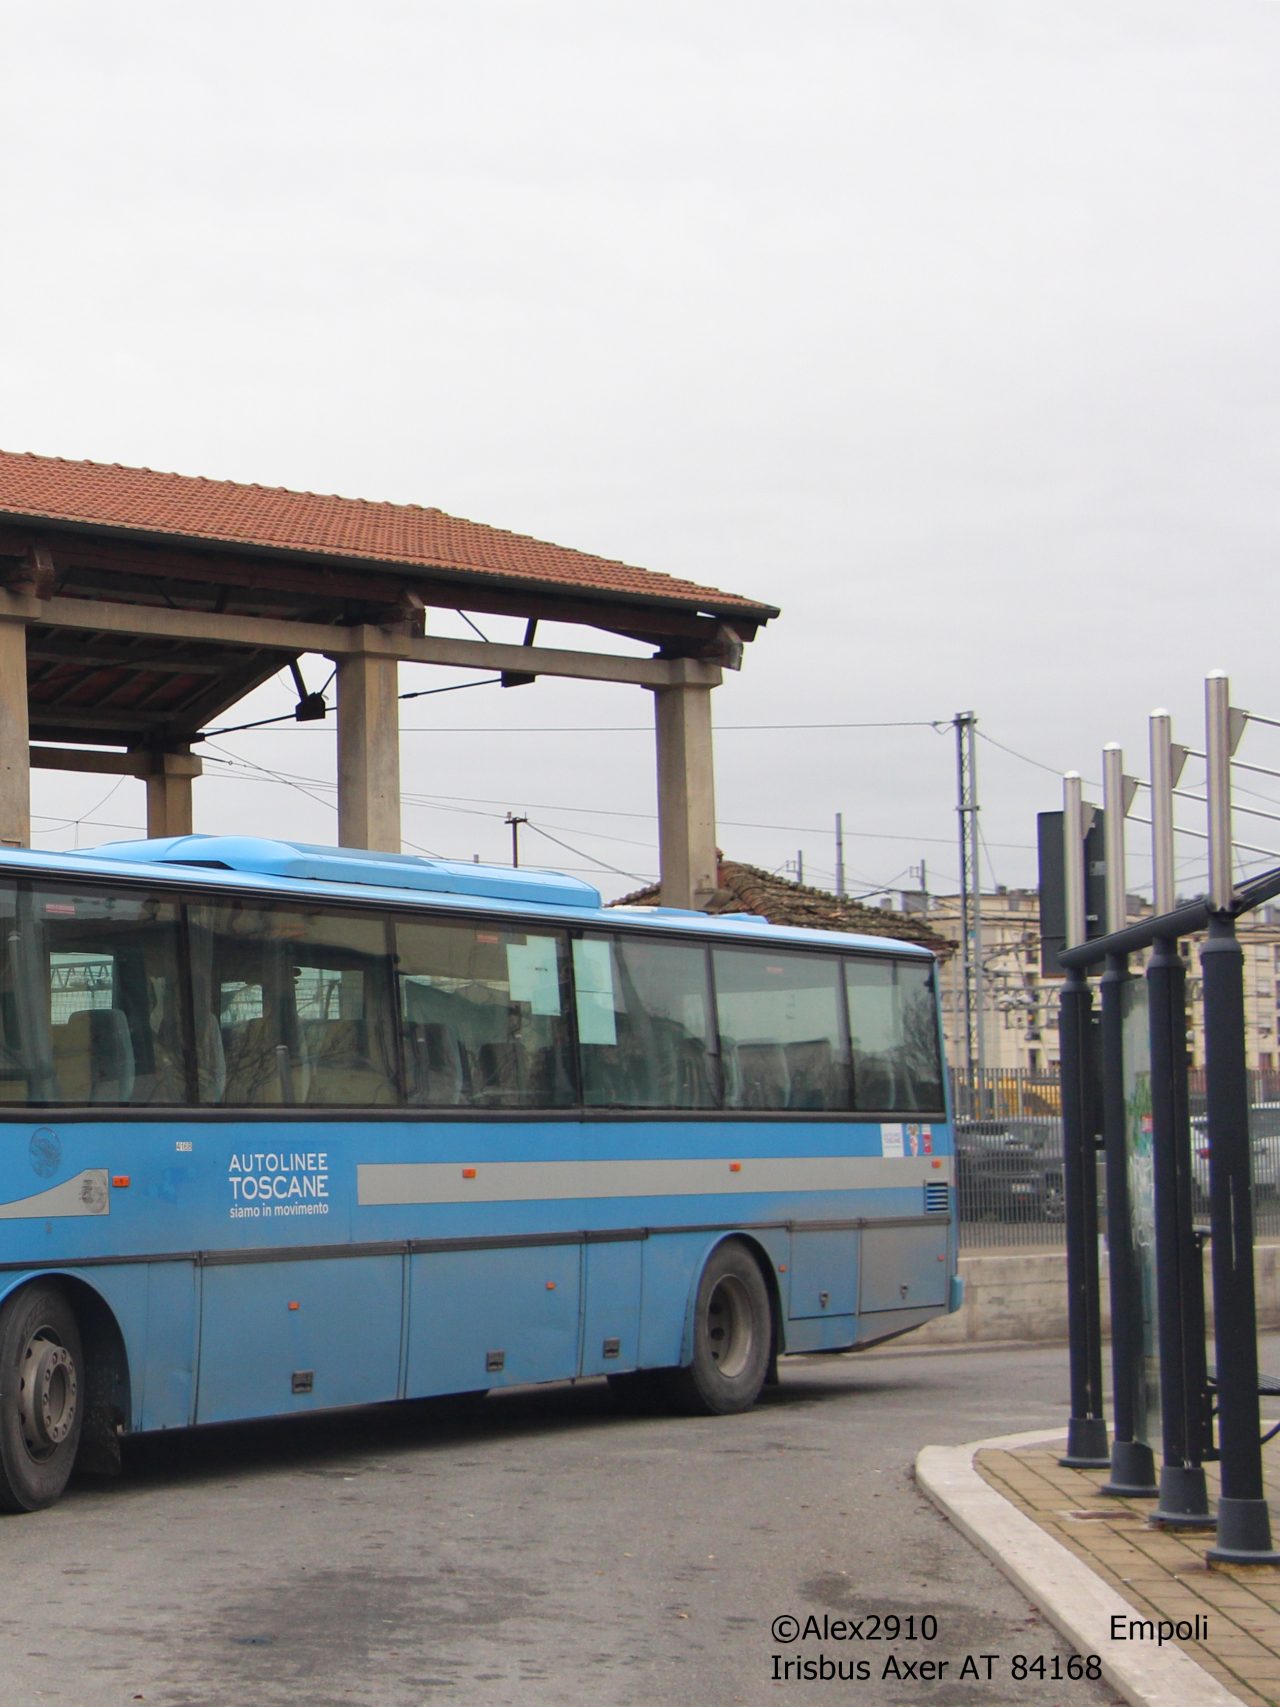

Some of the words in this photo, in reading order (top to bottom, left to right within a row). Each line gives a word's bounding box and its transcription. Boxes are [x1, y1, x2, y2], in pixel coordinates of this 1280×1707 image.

[228, 1153, 328, 1172] AUTOLINEE
[228, 1175, 329, 1199] TOSCANE
[229, 1204, 260, 1218] siamo
[262, 1203, 272, 1217] in
[274, 1201, 329, 1216] movimento
